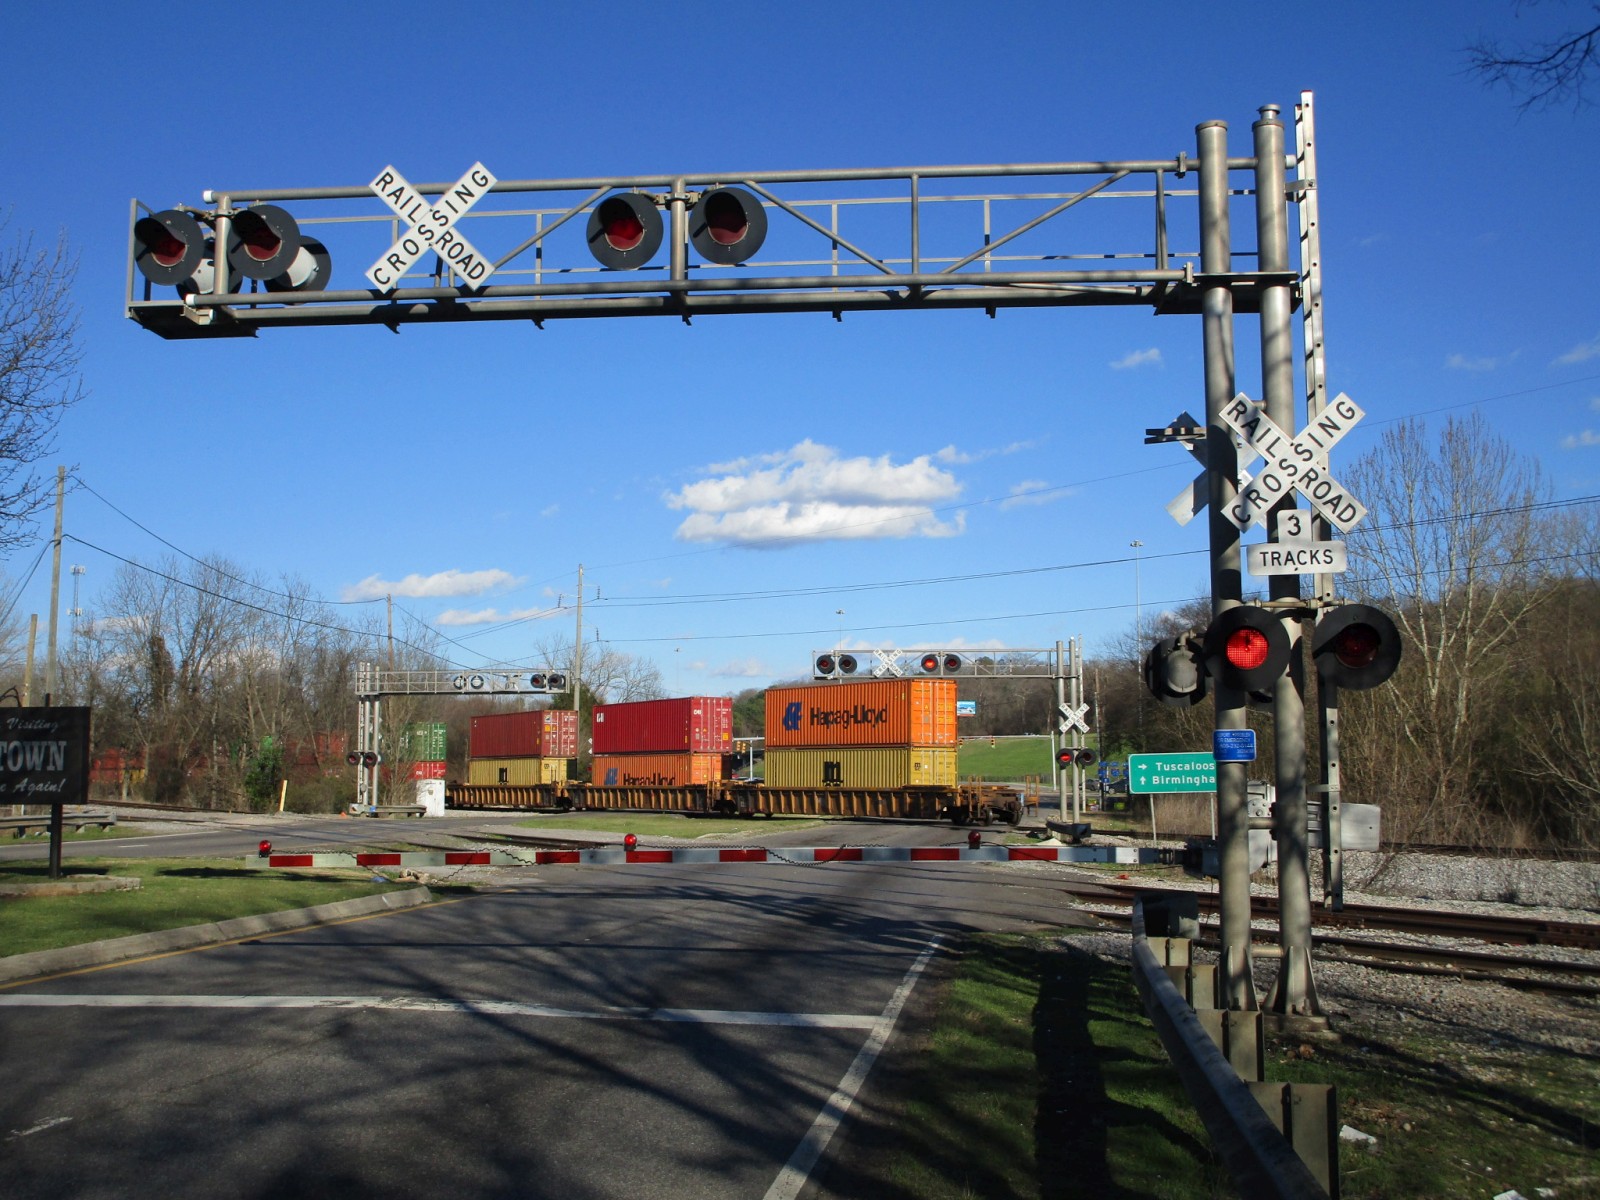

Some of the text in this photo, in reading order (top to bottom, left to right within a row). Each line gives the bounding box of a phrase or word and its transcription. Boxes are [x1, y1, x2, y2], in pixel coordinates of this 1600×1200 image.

[373, 170, 489, 285] CROSSING
[375, 171, 486, 280] RAIL ROAD
[1227, 400, 1356, 524] RAIL ROAD
[1231, 400, 1356, 524] CROSSING
[1287, 514, 1302, 536] 3
[1259, 549, 1334, 566] TRACKS
[6, 717, 58, 733] Visiting
[810, 704, 888, 729] Hapag-Lloyd
[1155, 762, 1215, 771] Tuscaloos
[12, 778, 66, 796] Again!
[1152, 775, 1216, 786] Birmingha
